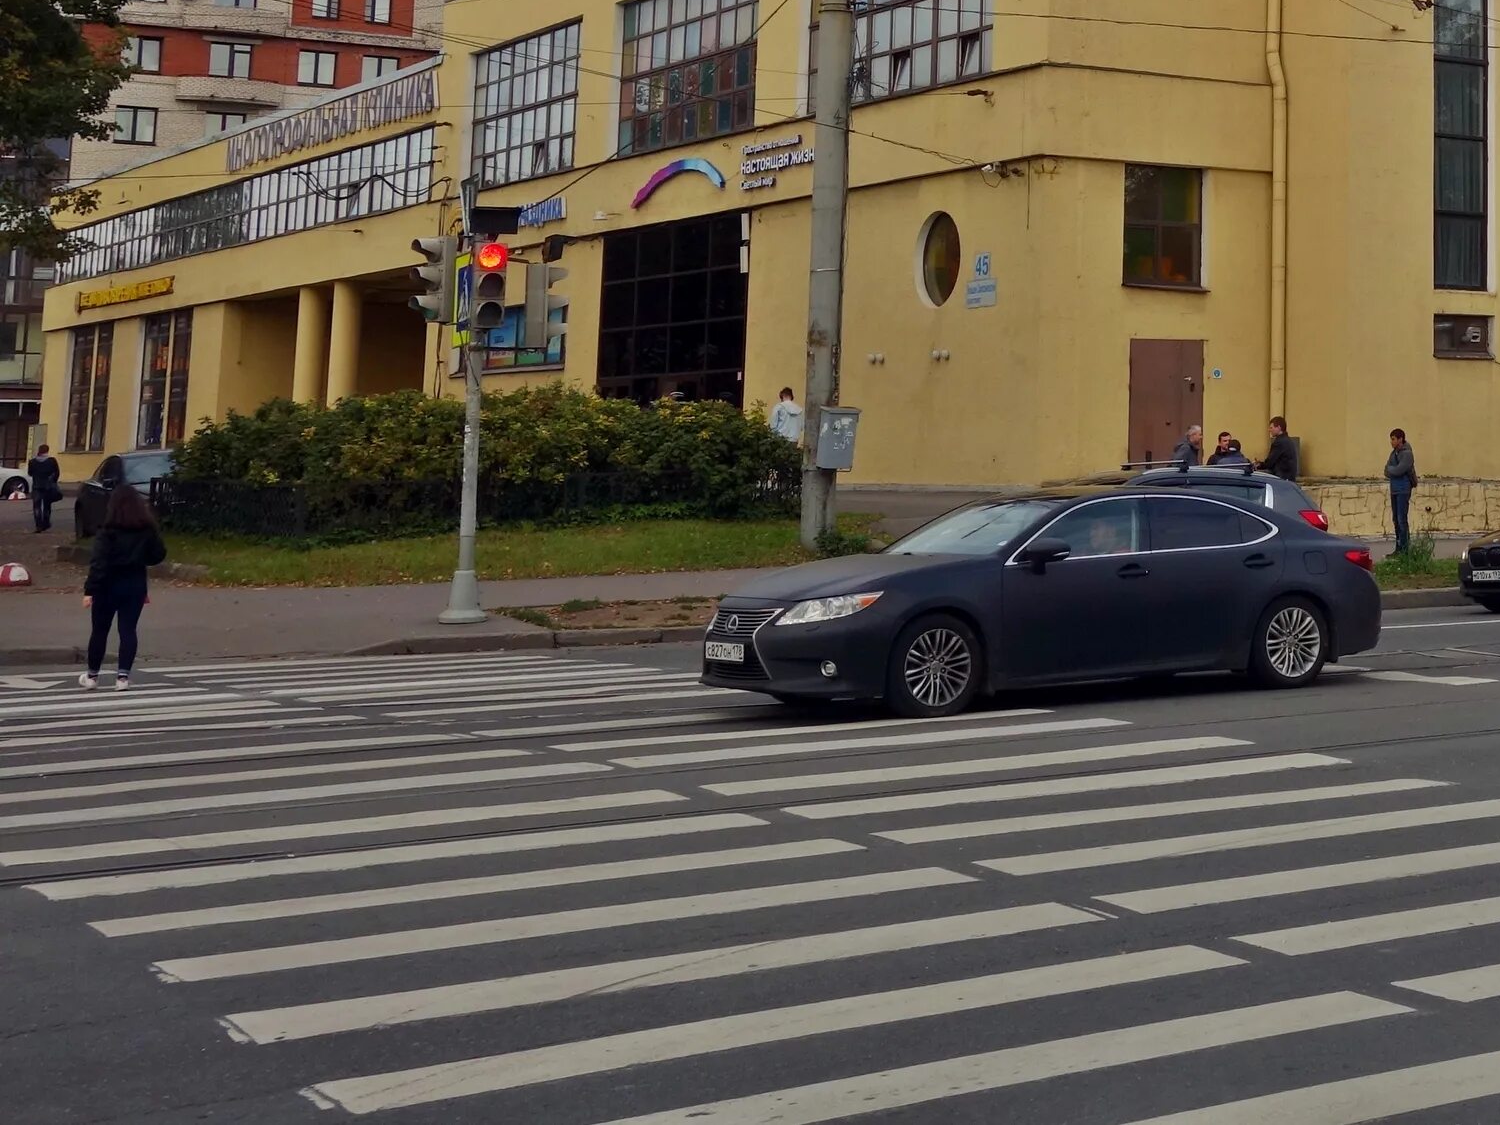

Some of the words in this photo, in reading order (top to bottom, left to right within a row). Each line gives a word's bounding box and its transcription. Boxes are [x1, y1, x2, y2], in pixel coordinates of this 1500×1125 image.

[226, 93, 359, 173] МНОГОПРОФИЛЬНАЯ
[361, 70, 438, 132] КЛИНИКА
[790, 147, 815, 165] жизн
[976, 255, 989, 276] 45
